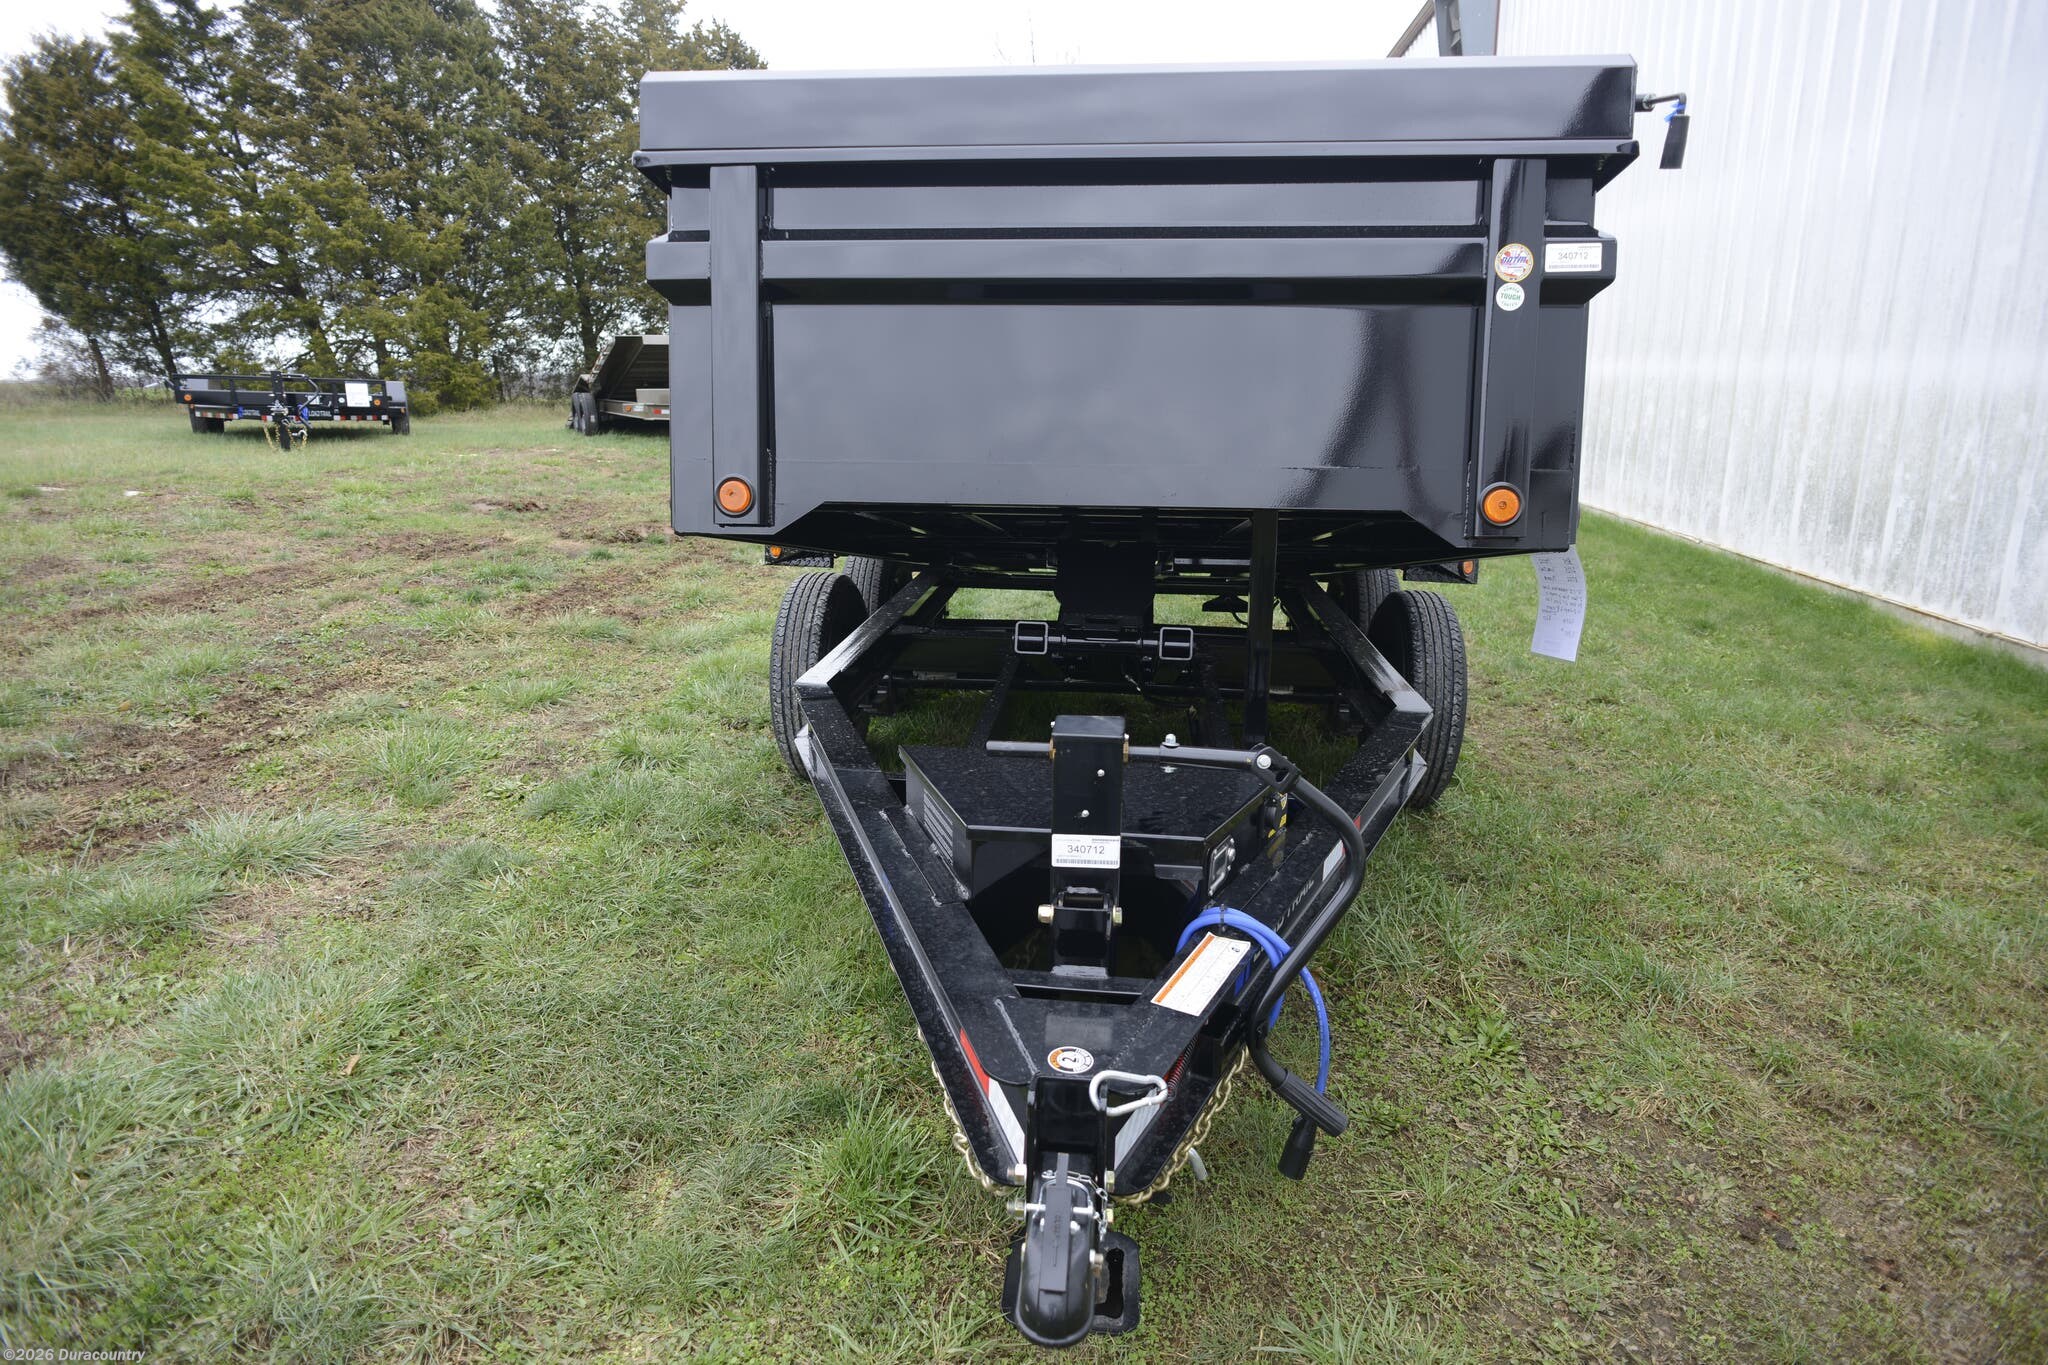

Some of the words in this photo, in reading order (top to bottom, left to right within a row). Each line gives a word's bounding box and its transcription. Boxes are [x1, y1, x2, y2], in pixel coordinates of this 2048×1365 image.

[1557, 251, 1589, 261] 340712
[1500, 292, 1521, 301] TOUGH
[1067, 844, 1105, 855] 340712
